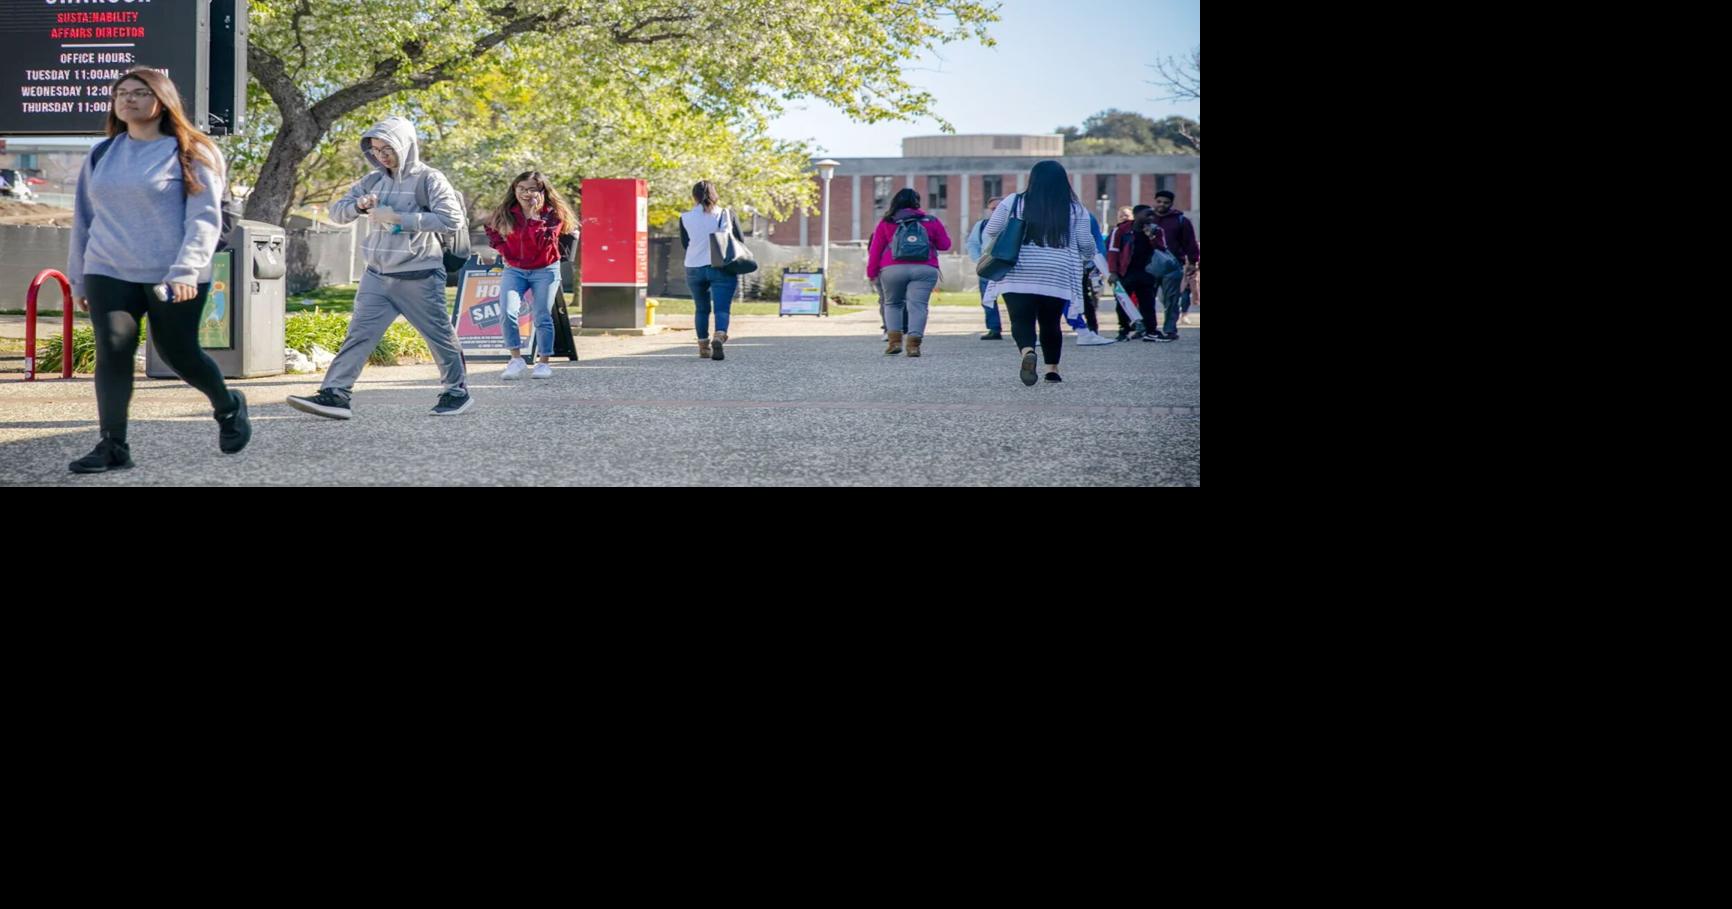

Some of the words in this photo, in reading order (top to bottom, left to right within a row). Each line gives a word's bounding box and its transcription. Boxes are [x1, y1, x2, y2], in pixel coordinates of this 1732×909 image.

[57, 12, 138, 23] SUSTAINABILITY
[51, 27, 93, 38] AFFAIRS
[95, 26, 145, 38] DIRECTOR
[60, 53, 95, 64] OFFICE
[98, 52, 135, 63] HOURS:
[26, 69, 70, 81] TUESDAY
[21, 86, 82, 97] WEDNESDAY
[22, 102, 74, 113] THURSDAY
[475, 284, 501, 298] HO
